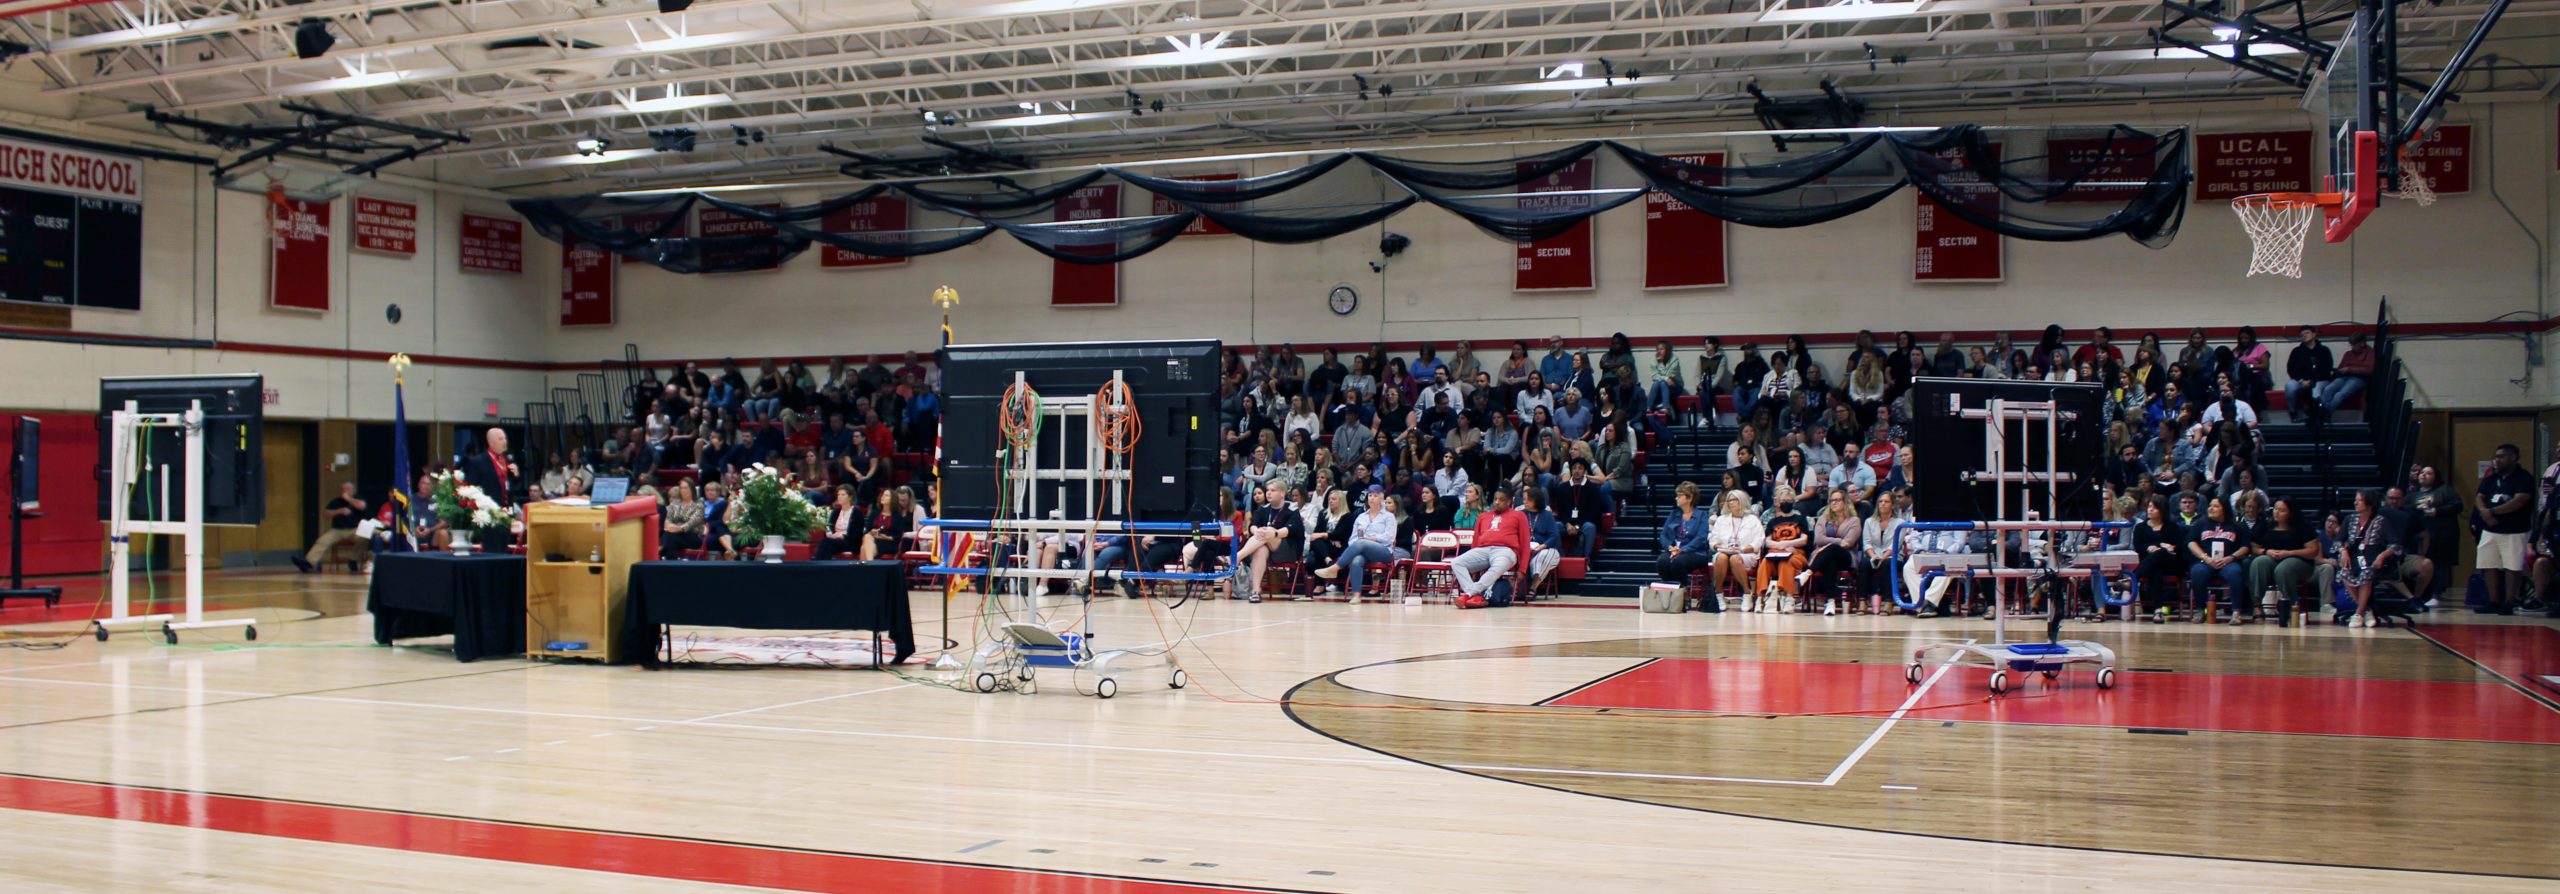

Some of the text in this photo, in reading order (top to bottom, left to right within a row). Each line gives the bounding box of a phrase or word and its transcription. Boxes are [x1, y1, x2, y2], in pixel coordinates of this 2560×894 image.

[2220, 138, 2288, 153] UCAL
[2427, 146, 2464, 157] SKIING
[2216, 157, 2278, 166] SECTION
[0, 145, 136, 195] IGH SCHOOL
[2208, 181, 2300, 193] GIRLS SKIING
[1520, 198, 1550, 208] TRACK
[1560, 196, 1589, 206] FIELD
[363, 201, 410, 217] LADY HOOPS
[1069, 208, 1102, 220] INDIANS
[34, 214, 70, 229] GUEST
[1938, 236, 1977, 247] SECTION
[1537, 247, 1571, 257] SECTION
[262, 392, 279, 404] EXIT
